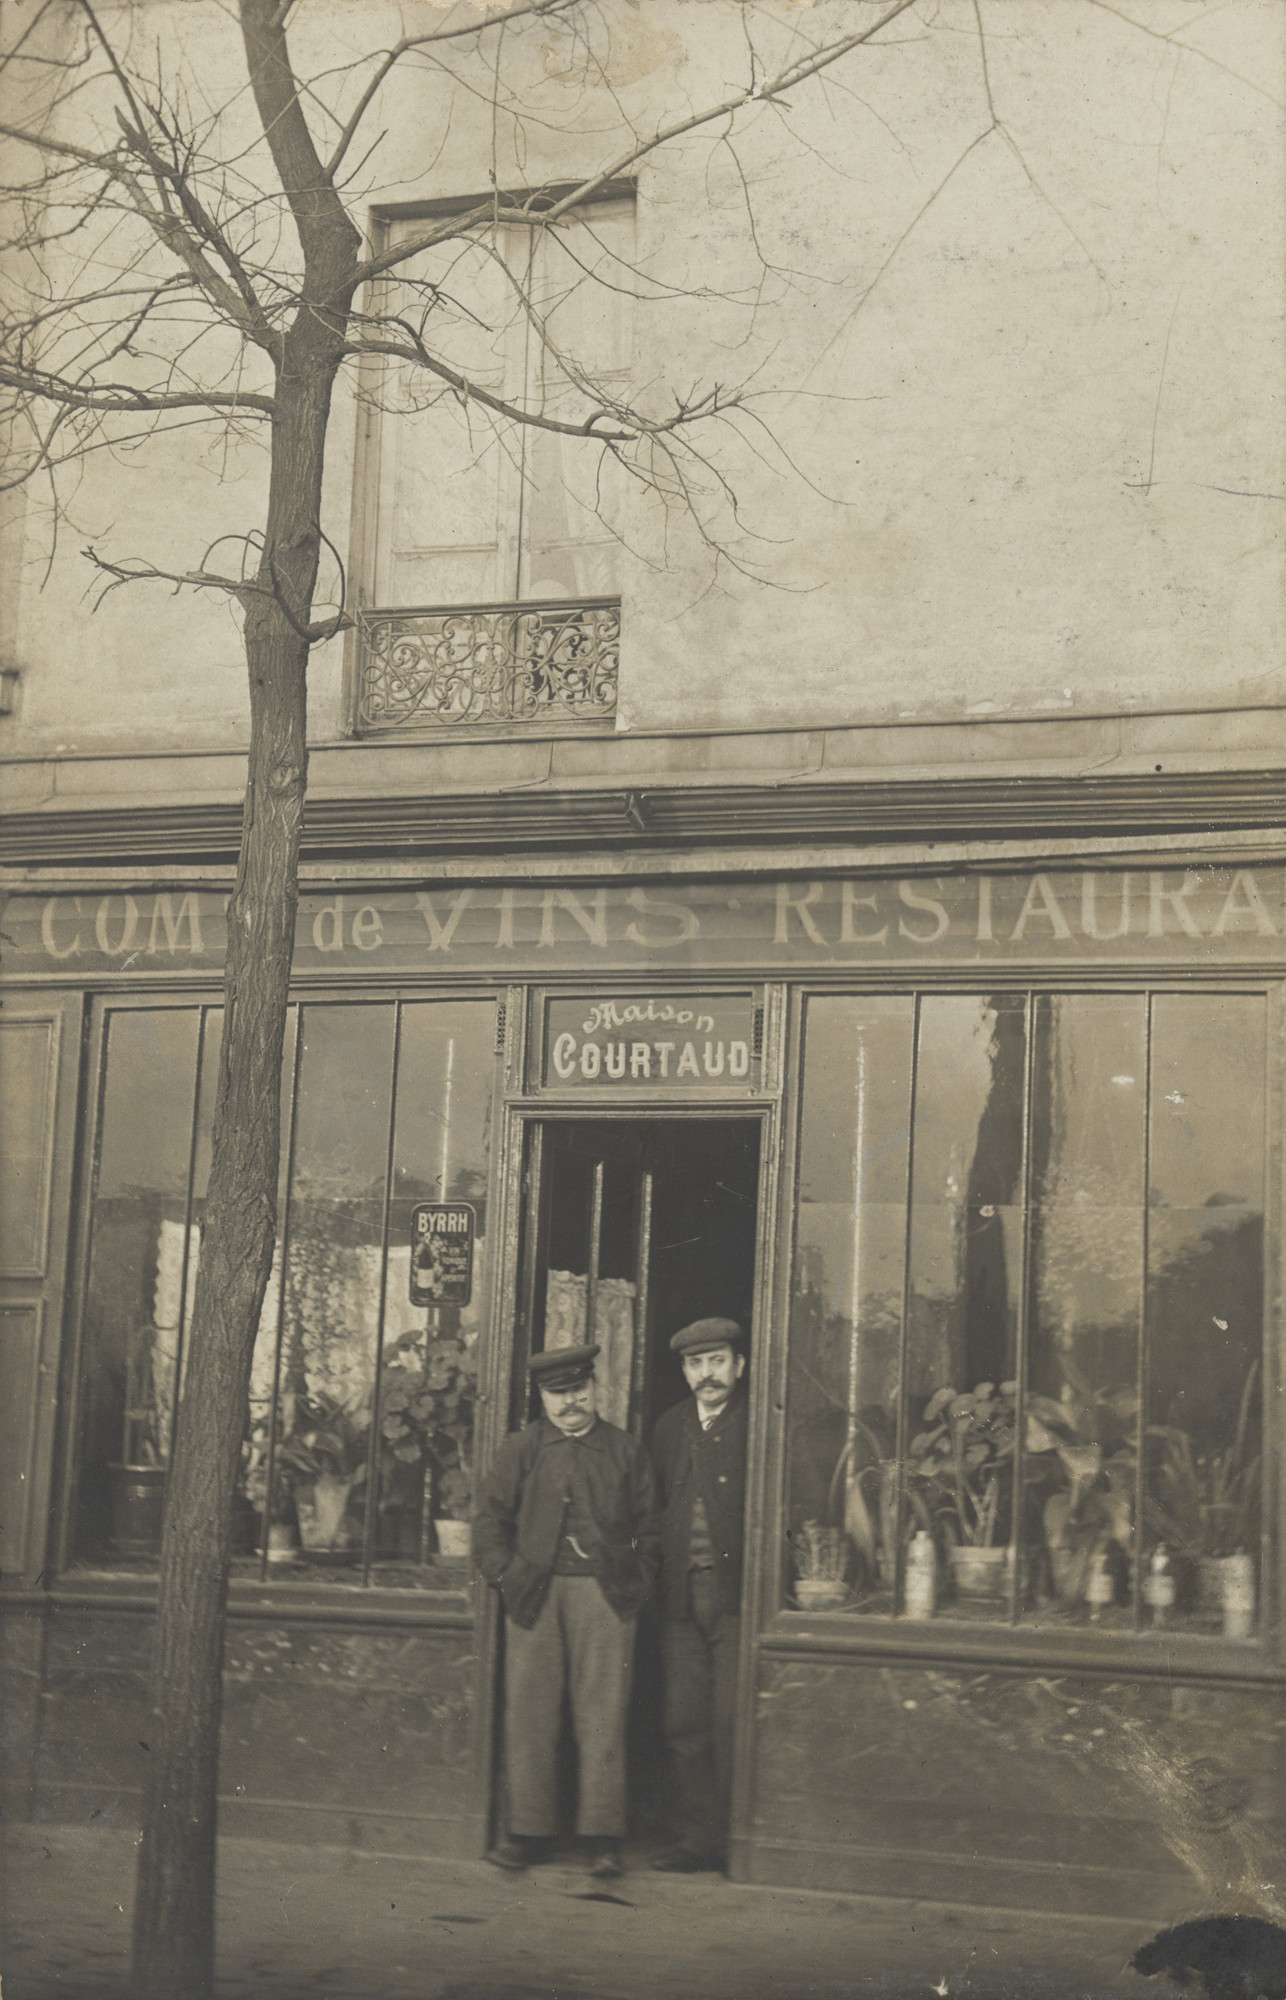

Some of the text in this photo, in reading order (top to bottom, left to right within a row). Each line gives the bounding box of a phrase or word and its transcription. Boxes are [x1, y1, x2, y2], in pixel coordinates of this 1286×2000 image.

[41, 893, 231, 958] COM
[312, 894, 384, 951] de
[415, 886, 699, 952] VINS
[582, 1000, 715, 1034] Maison
[553, 1033, 749, 1078] COURTAUD
[418, 1212, 468, 1232] BYRRH
